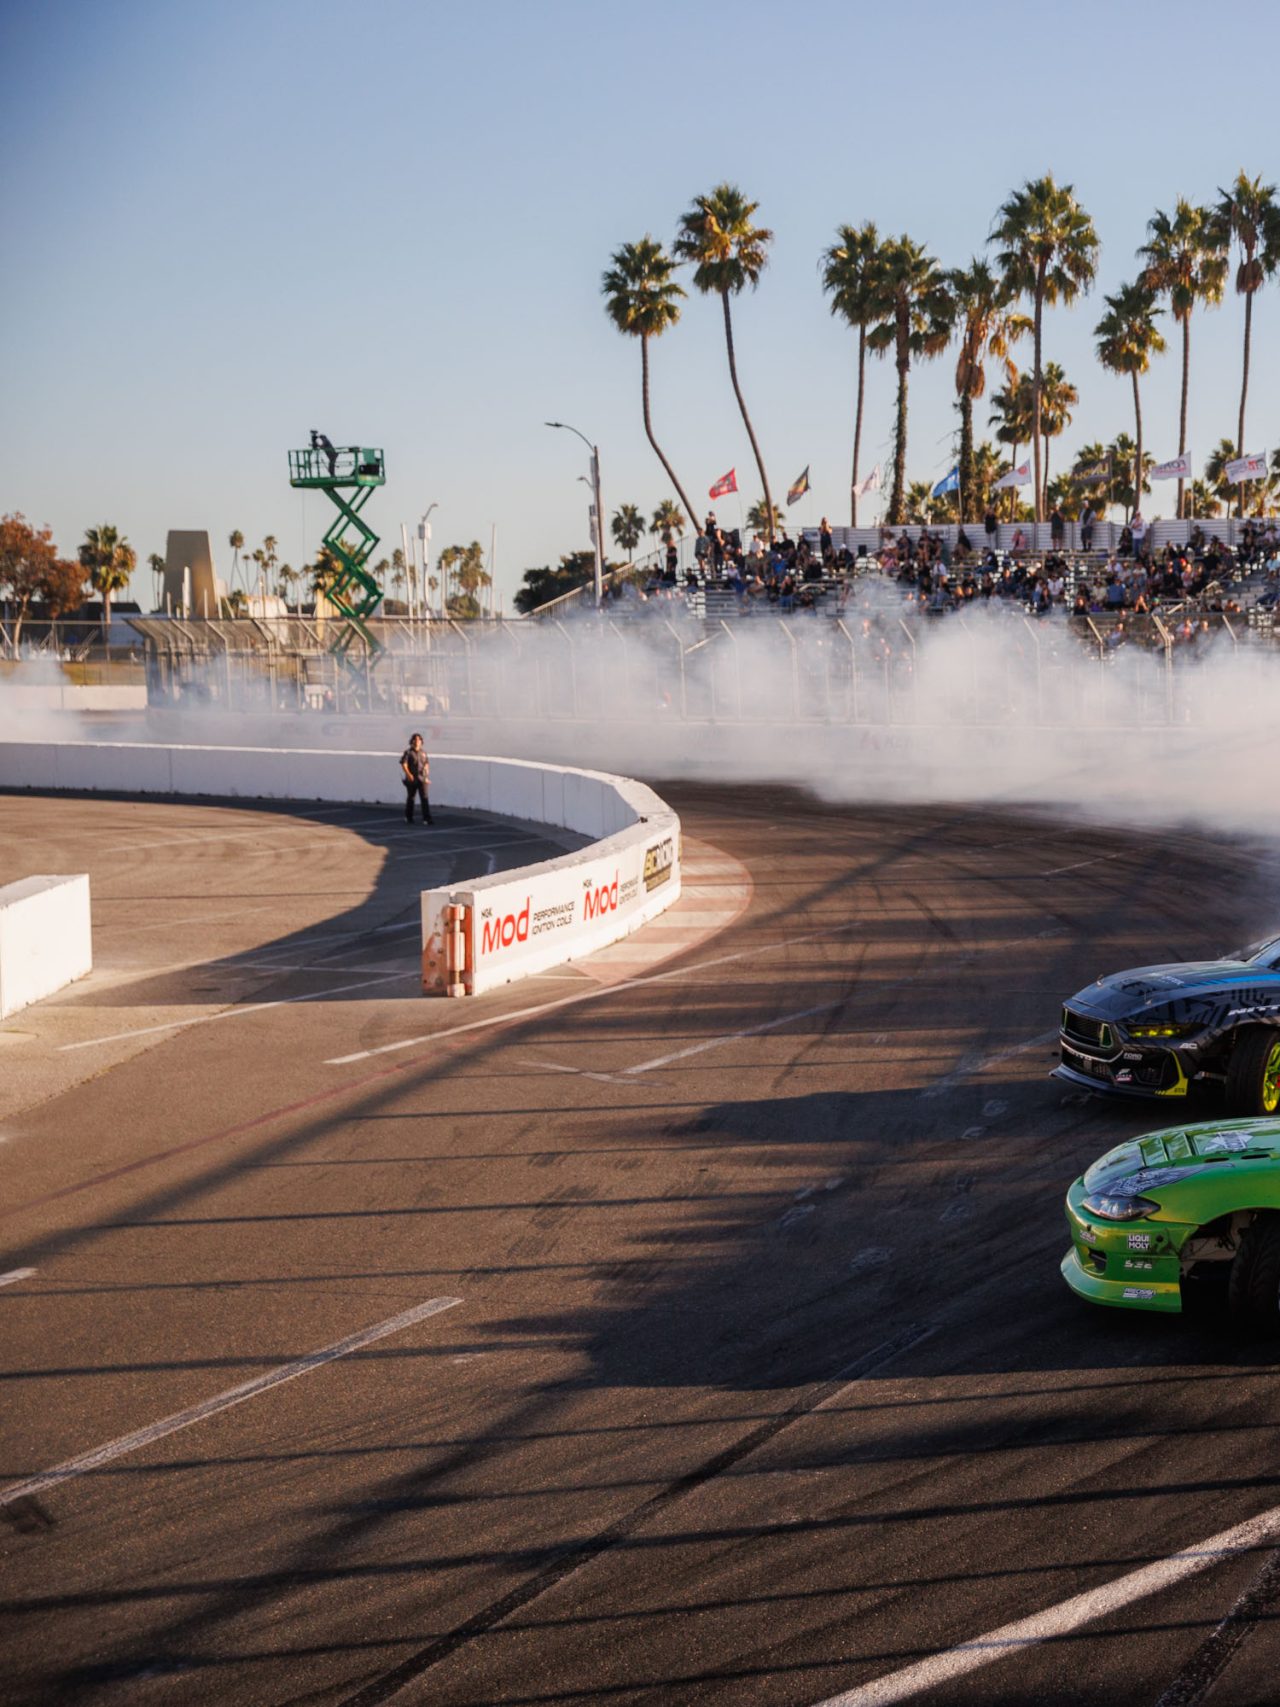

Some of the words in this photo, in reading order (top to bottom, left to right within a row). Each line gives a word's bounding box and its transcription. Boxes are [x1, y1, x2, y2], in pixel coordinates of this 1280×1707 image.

[533, 901, 575, 922] PERFORMANCE
[583, 868, 619, 921] Mod
[482, 896, 530, 955] Mod
